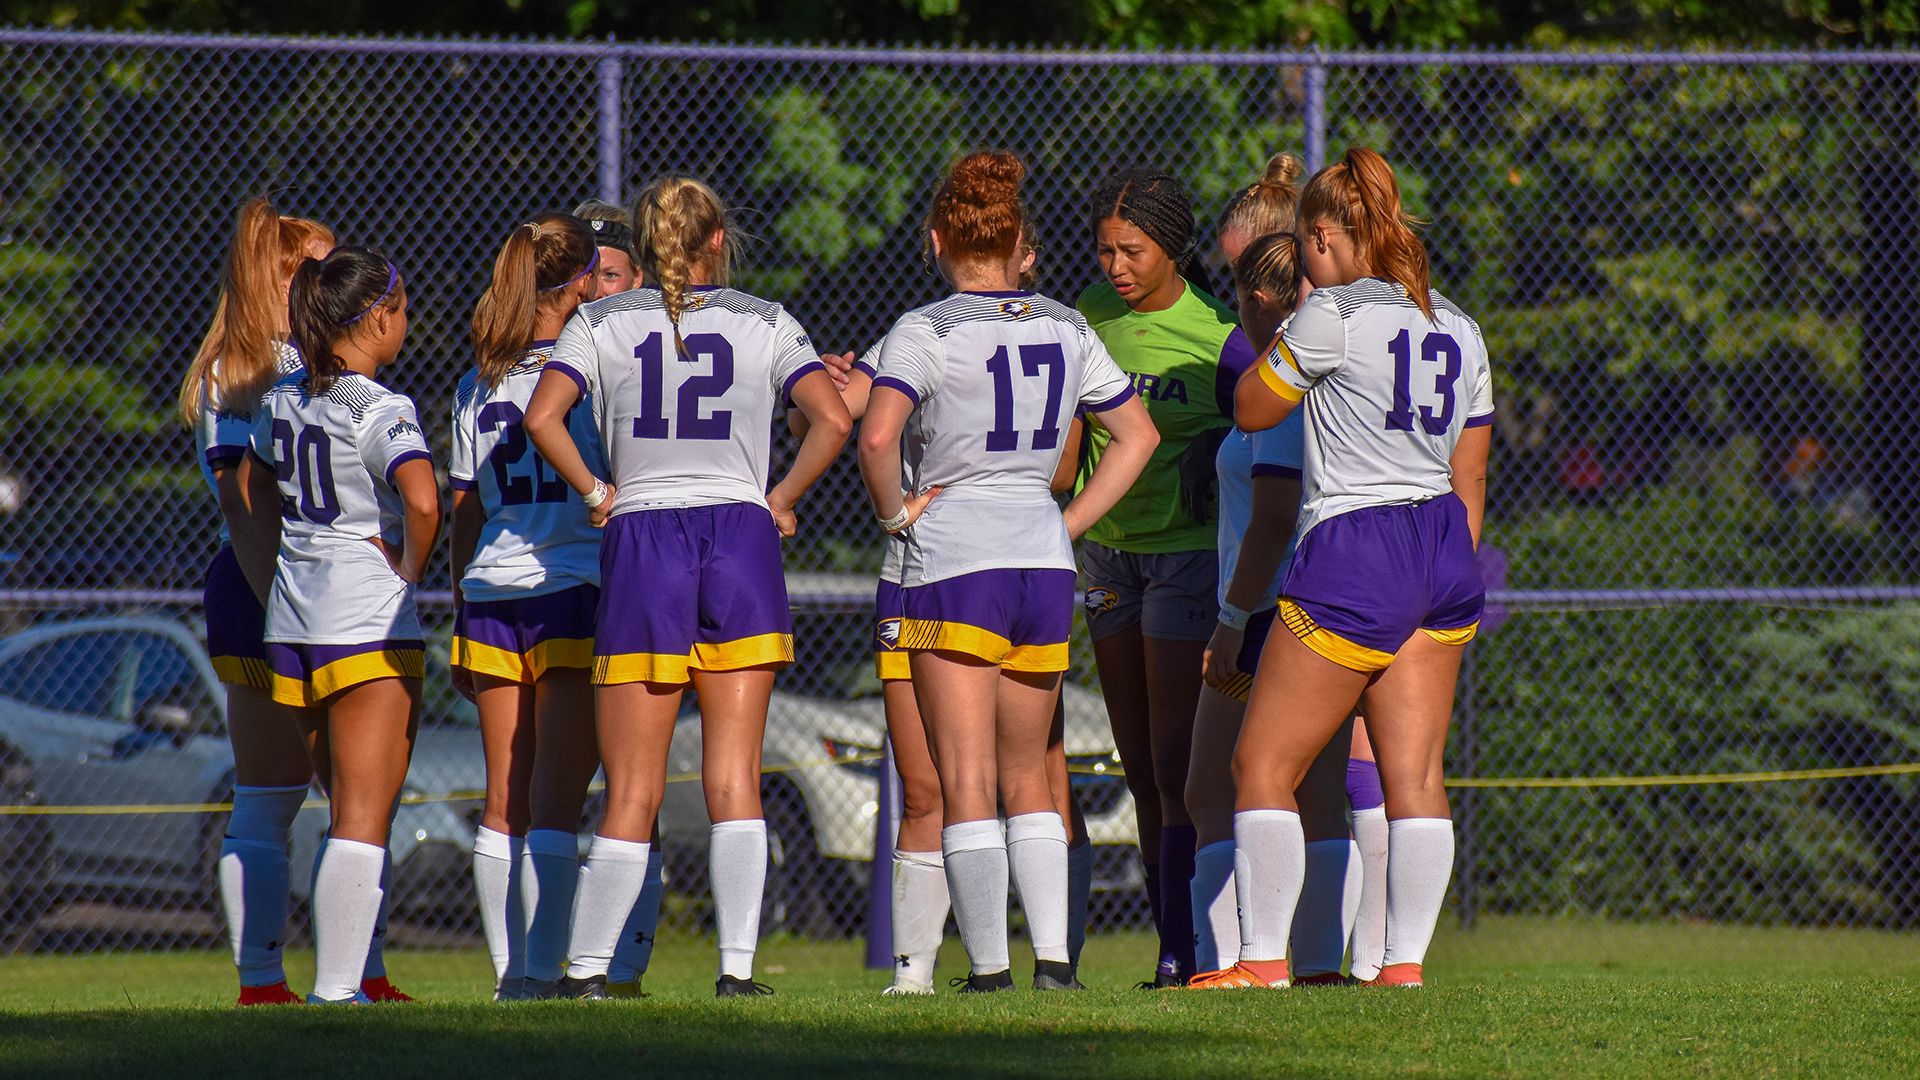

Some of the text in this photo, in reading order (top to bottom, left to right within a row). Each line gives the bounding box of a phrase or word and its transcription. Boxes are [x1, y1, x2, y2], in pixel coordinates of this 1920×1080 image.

[633, 331, 734, 440] 12
[985, 342, 1066, 452] 17
[1124, 370, 1188, 405] IRA
[1384, 328, 1462, 436] 13
[271, 418, 341, 526] 20
